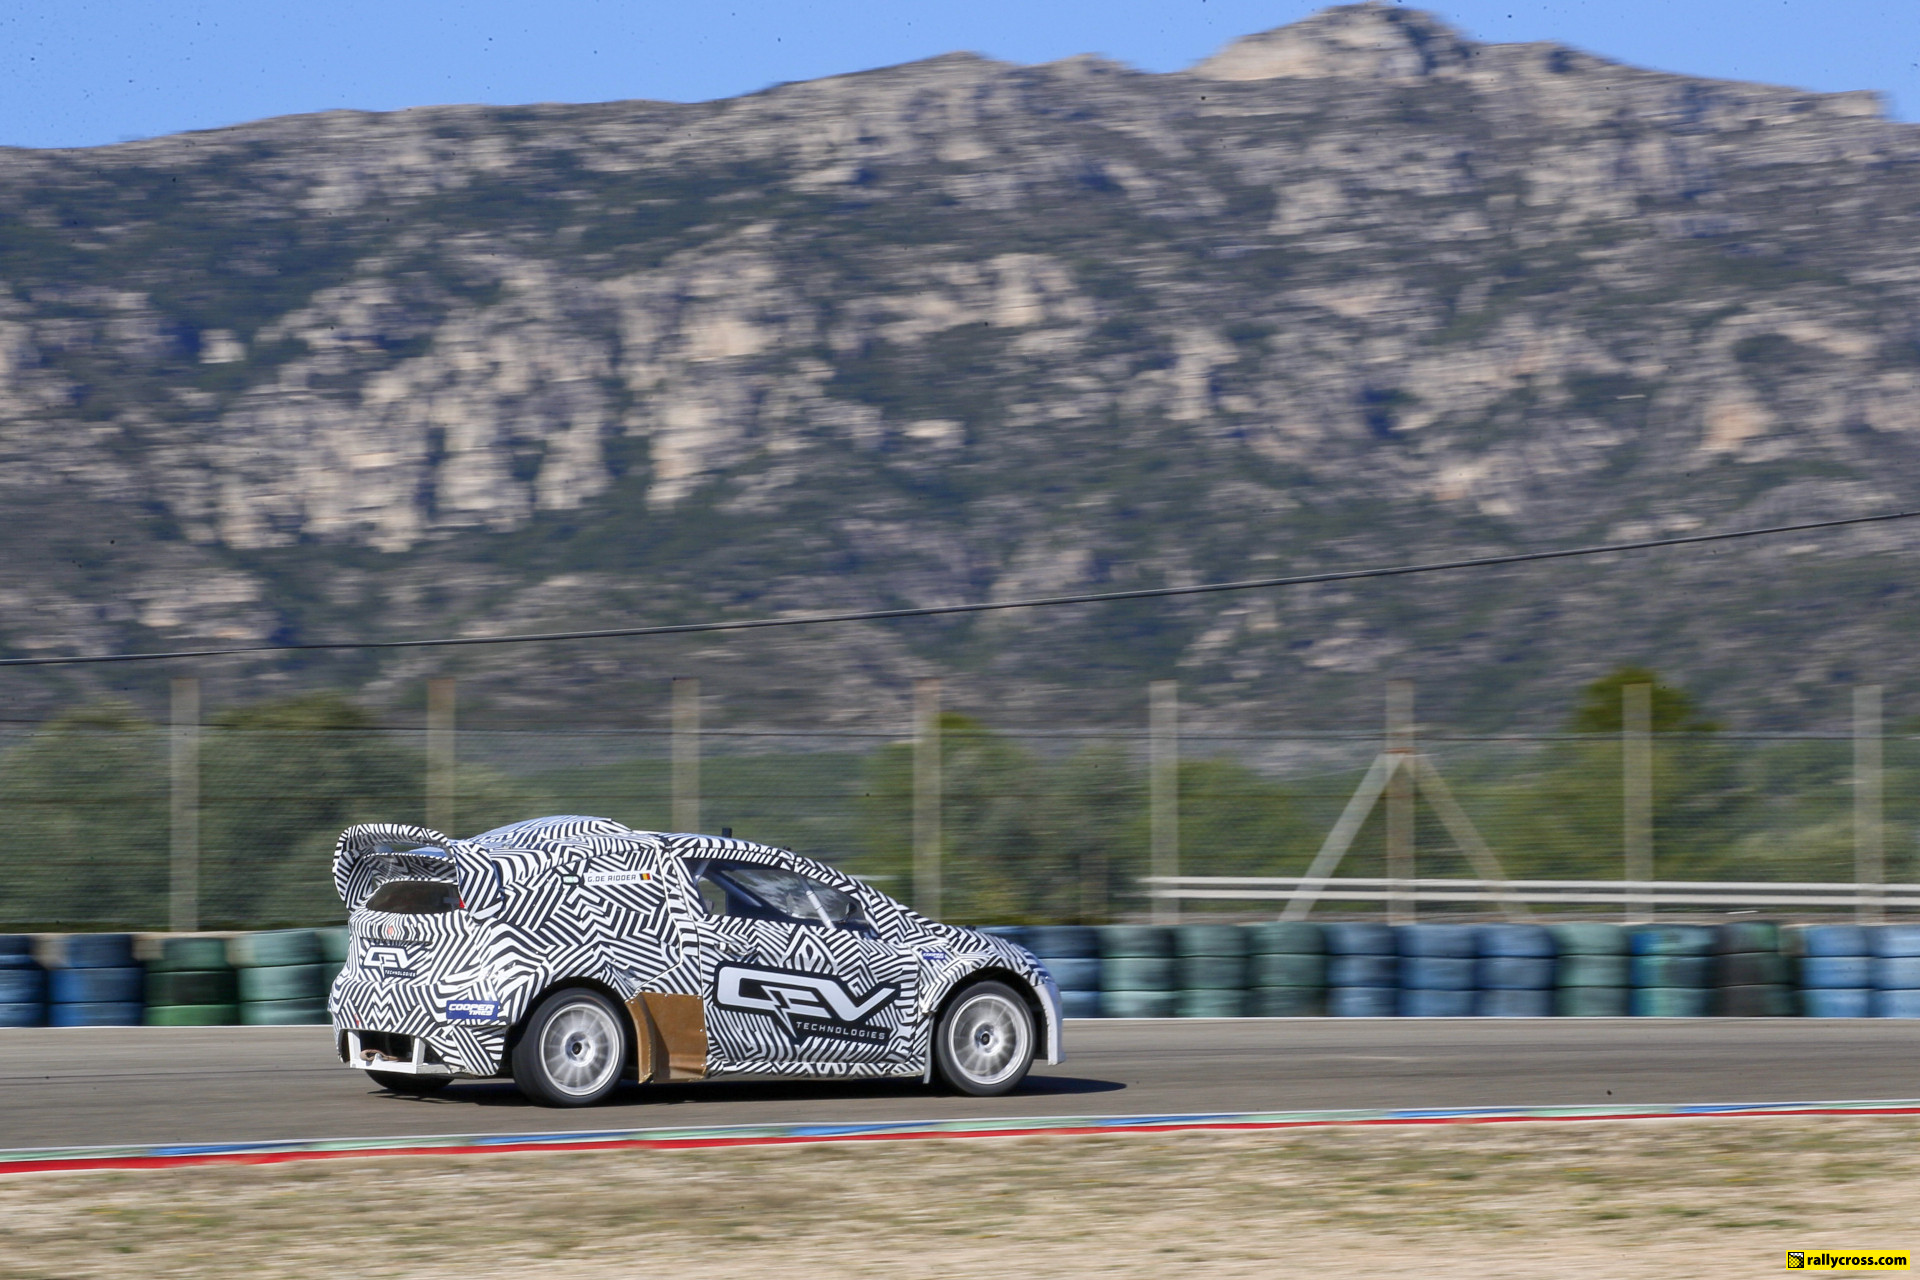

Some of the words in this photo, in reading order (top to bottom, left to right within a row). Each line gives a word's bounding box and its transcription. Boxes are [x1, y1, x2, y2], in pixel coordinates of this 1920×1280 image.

[607, 874, 637, 882] RIDDER
[384, 969, 417, 978] TECHNOLOGIES
[448, 1003, 496, 1011] COOPER
[796, 1021, 885, 1040] TECHNOLOGIES
